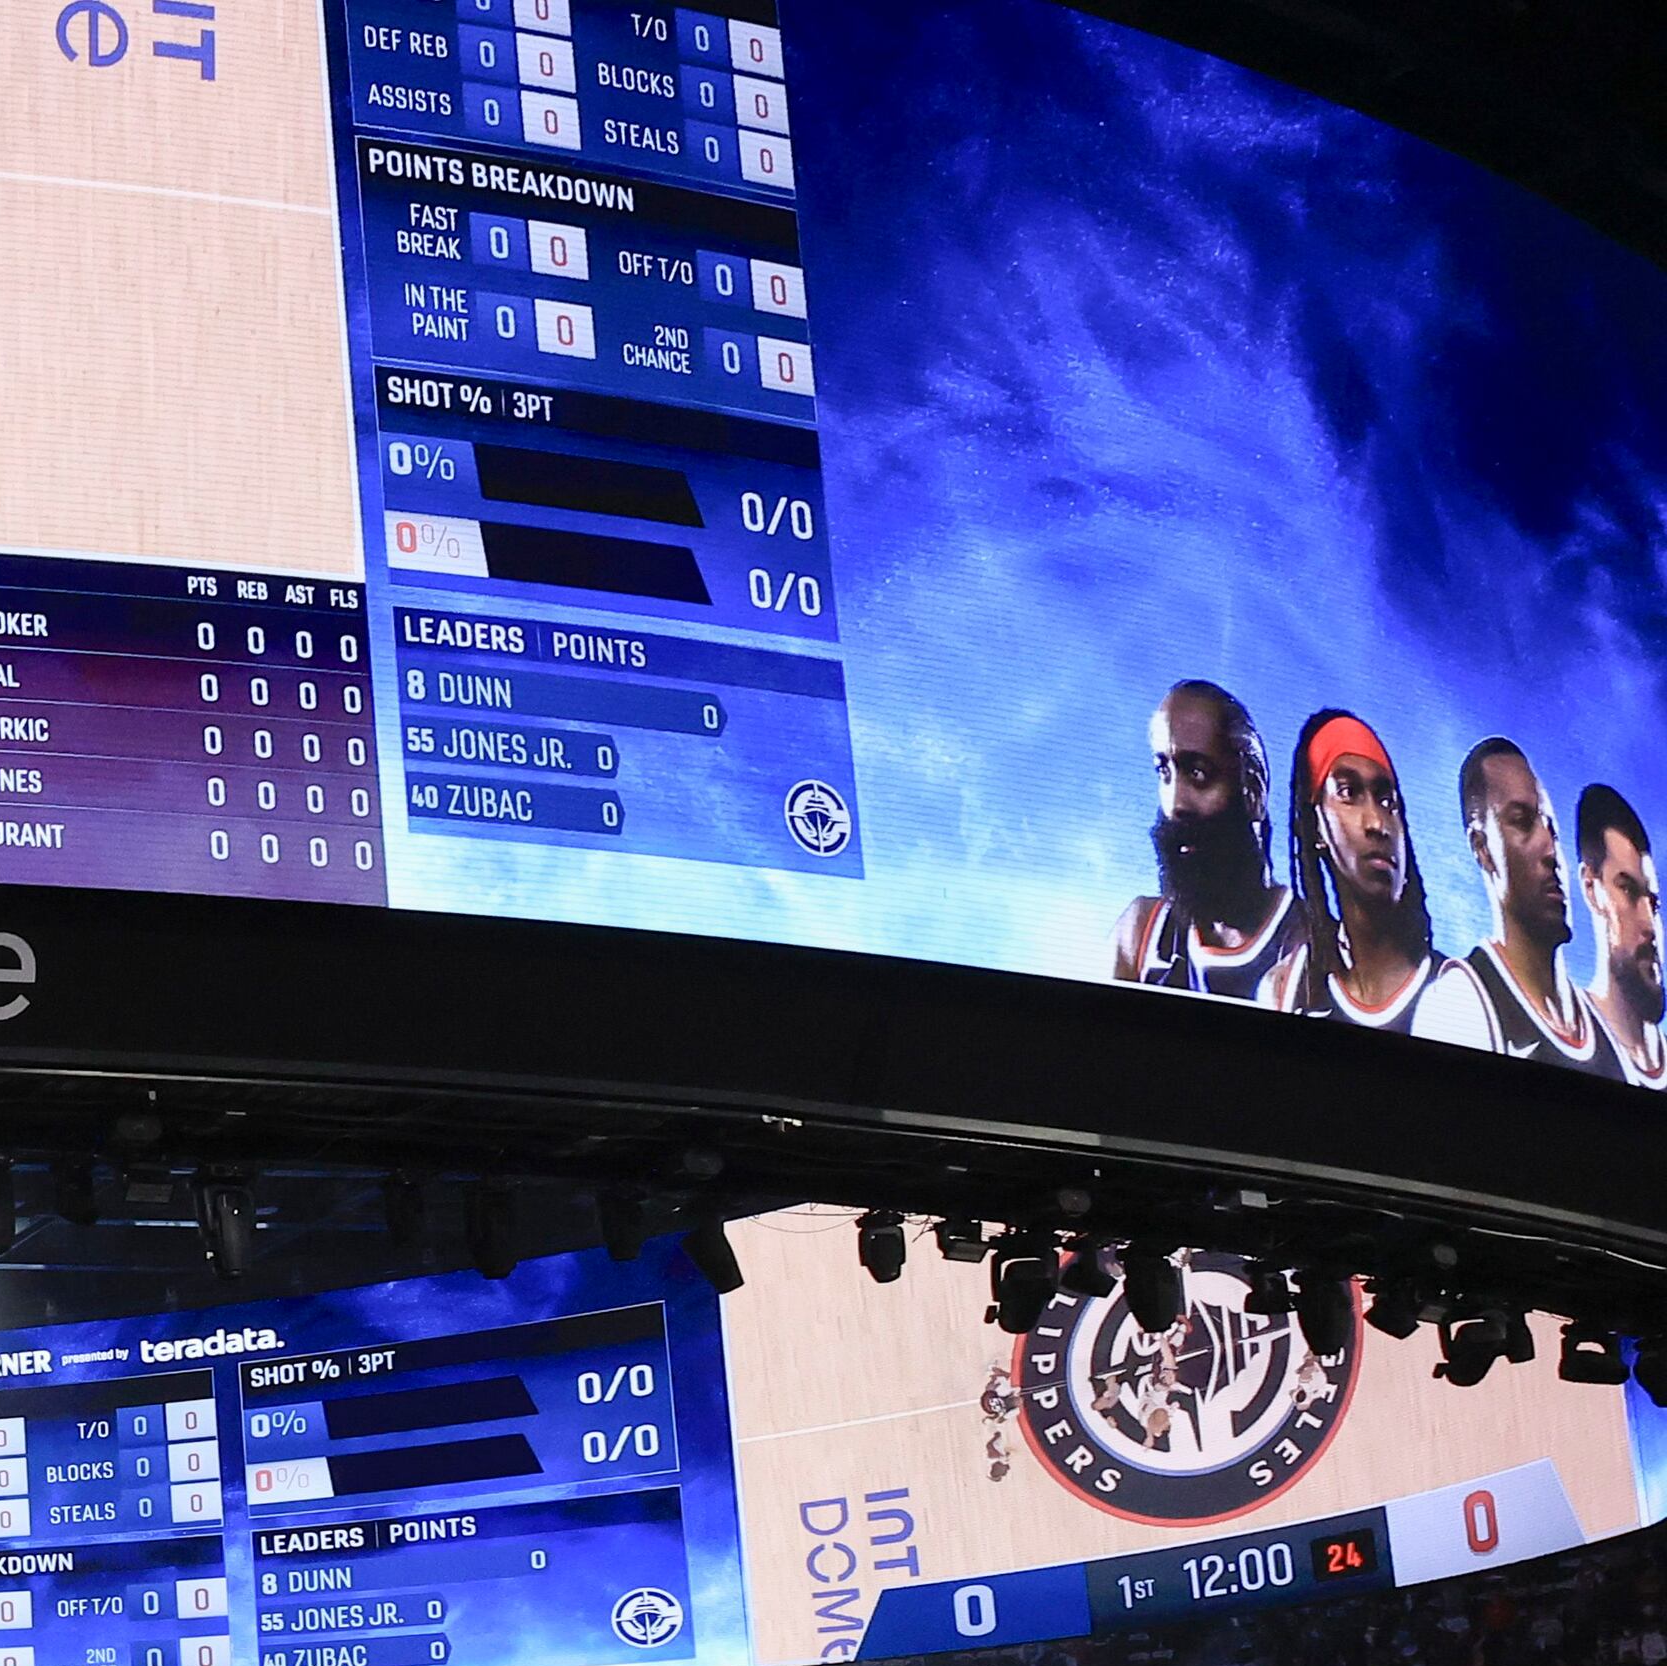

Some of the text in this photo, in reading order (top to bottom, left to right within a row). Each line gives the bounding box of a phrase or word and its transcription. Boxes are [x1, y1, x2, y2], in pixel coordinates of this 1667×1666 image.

[388, 376, 553, 421] SHOT % 3PT
[742, 493, 812, 539] 0/0
[405, 616, 645, 667] LEADERS POINTS
[261, 1516, 476, 1554] LEADERS POINTS
[1118, 1543, 1362, 1608] 1ST 12:00 24
